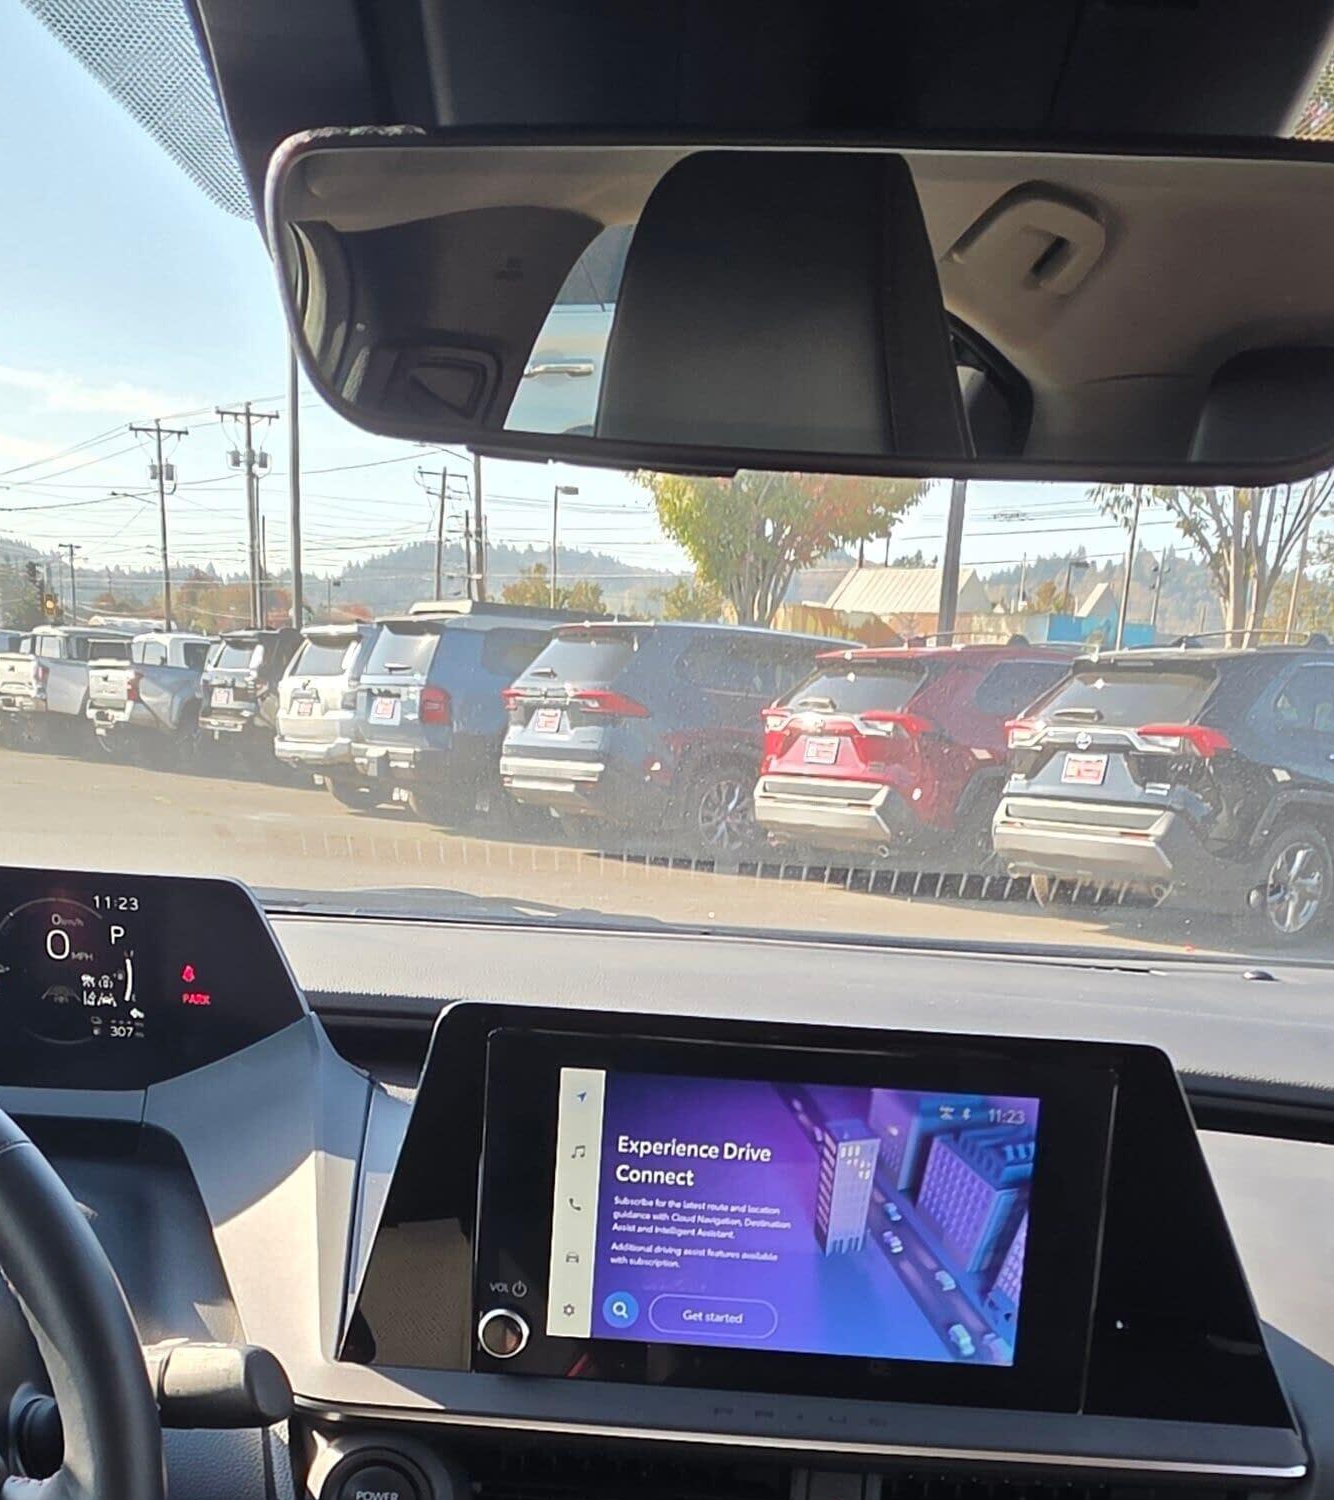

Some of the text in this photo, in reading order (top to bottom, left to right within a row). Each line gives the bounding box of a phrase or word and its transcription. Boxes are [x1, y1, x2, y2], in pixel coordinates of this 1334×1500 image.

[93, 895, 139, 911] 11:23
[110, 925, 125, 945] P
[46, 929, 70, 960] 0
[182, 993, 211, 1005] PARK
[110, 1026, 134, 1038] 307
[988, 1107, 1025, 1125] 11:23
[618, 1135, 771, 1162] Experience Drive
[616, 1164, 694, 1186] Connect
[614, 1195, 781, 1215] Subscribe for the latest route and location
[652, 1211, 669, 1221] with
[671, 1213, 697, 1224] Cloud
[612, 1222, 636, 1233] Assist
[637, 1224, 653, 1234] and
[610, 1255, 628, 1265] with
[611, 1242, 653, 1253] Additional
[654, 1245, 682, 1257] driving
[707, 1248, 740, 1259] features
[741, 1251, 779, 1262] available
[489, 1282, 509, 1293] VOL
[682, 1309, 744, 1324] Get started
